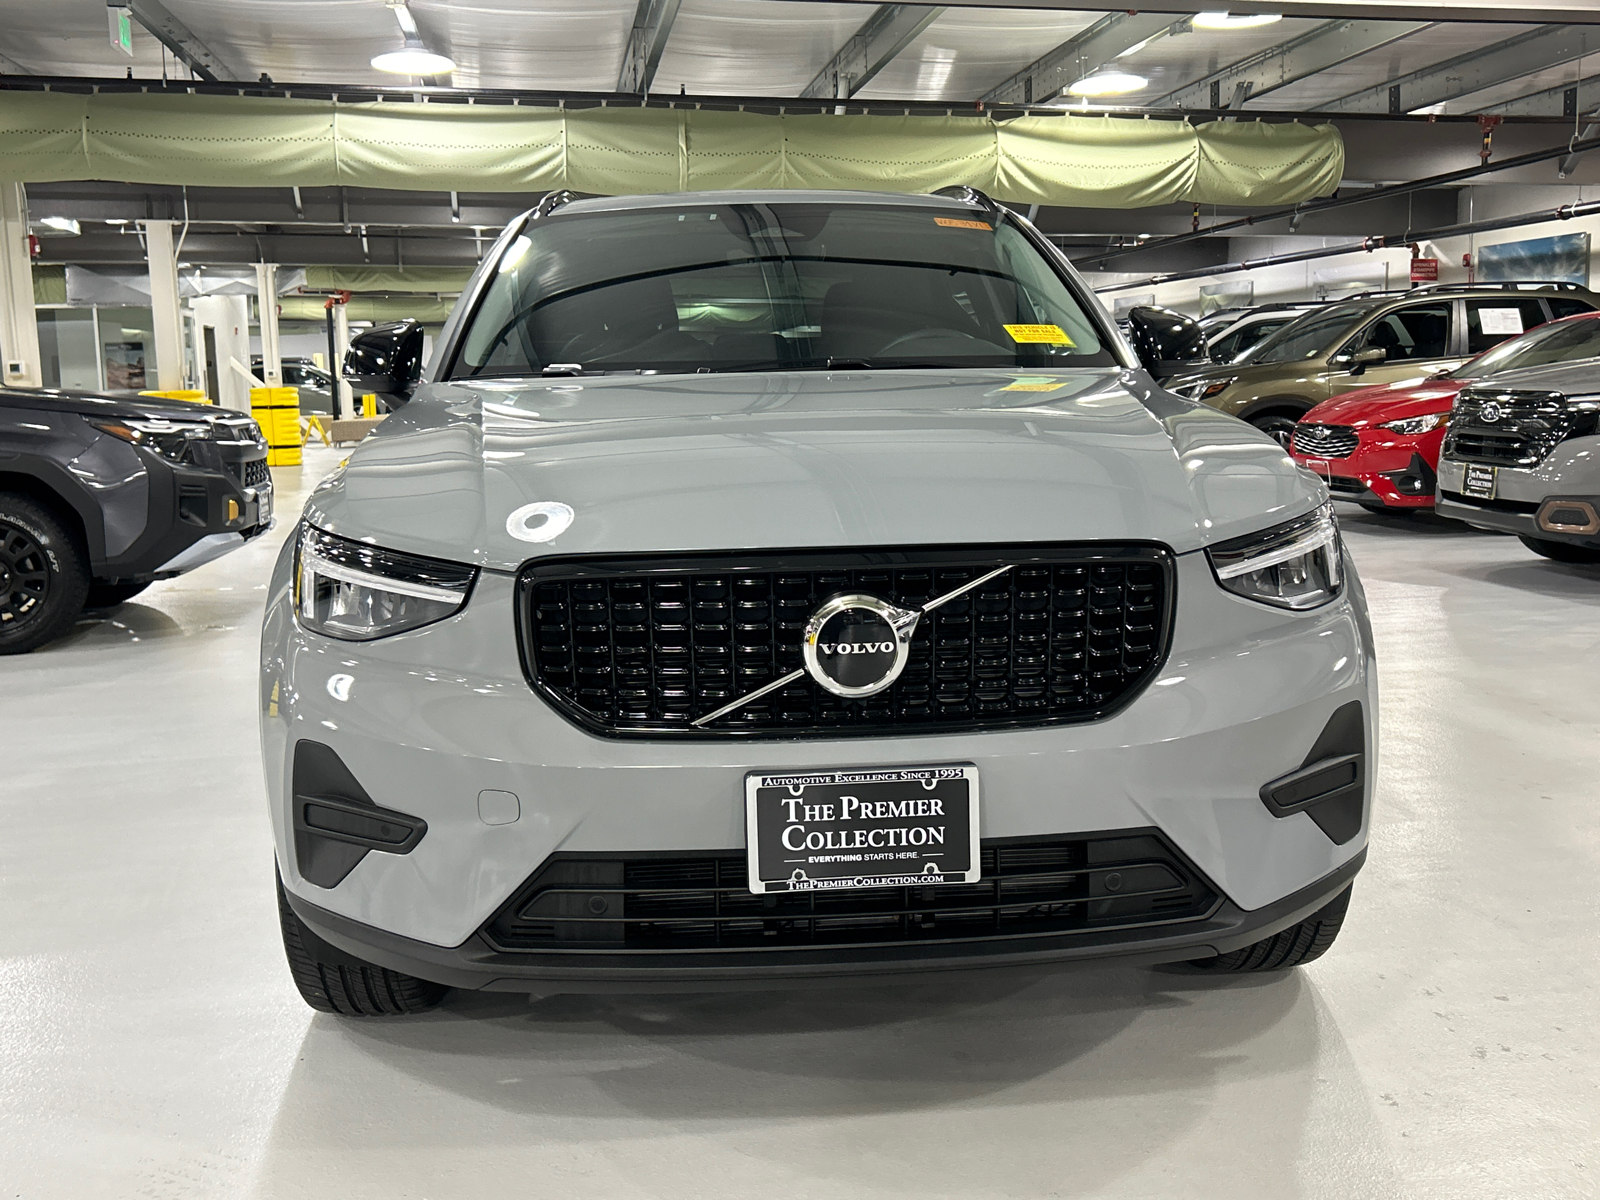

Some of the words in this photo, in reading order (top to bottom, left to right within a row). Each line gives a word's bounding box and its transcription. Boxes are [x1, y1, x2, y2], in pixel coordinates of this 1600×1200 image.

[819, 642, 894, 654] VOLVO
[764, 776, 831, 786] AUTOMOTIVE
[834, 773, 898, 783] EXCELLENCE
[900, 771, 931, 780] SINCE
[934, 769, 962, 778] 1995
[781, 798, 836, 823] THE
[839, 795, 945, 820] PREMIER
[781, 825, 946, 851] COLLECTION
[808, 854, 863, 863] EVERYTHING
[863, 852, 894, 861] STARTS
[895, 851, 920, 859] HERE.
[786, 875, 944, 890] THEPREMIERCOLLECTION.COM
